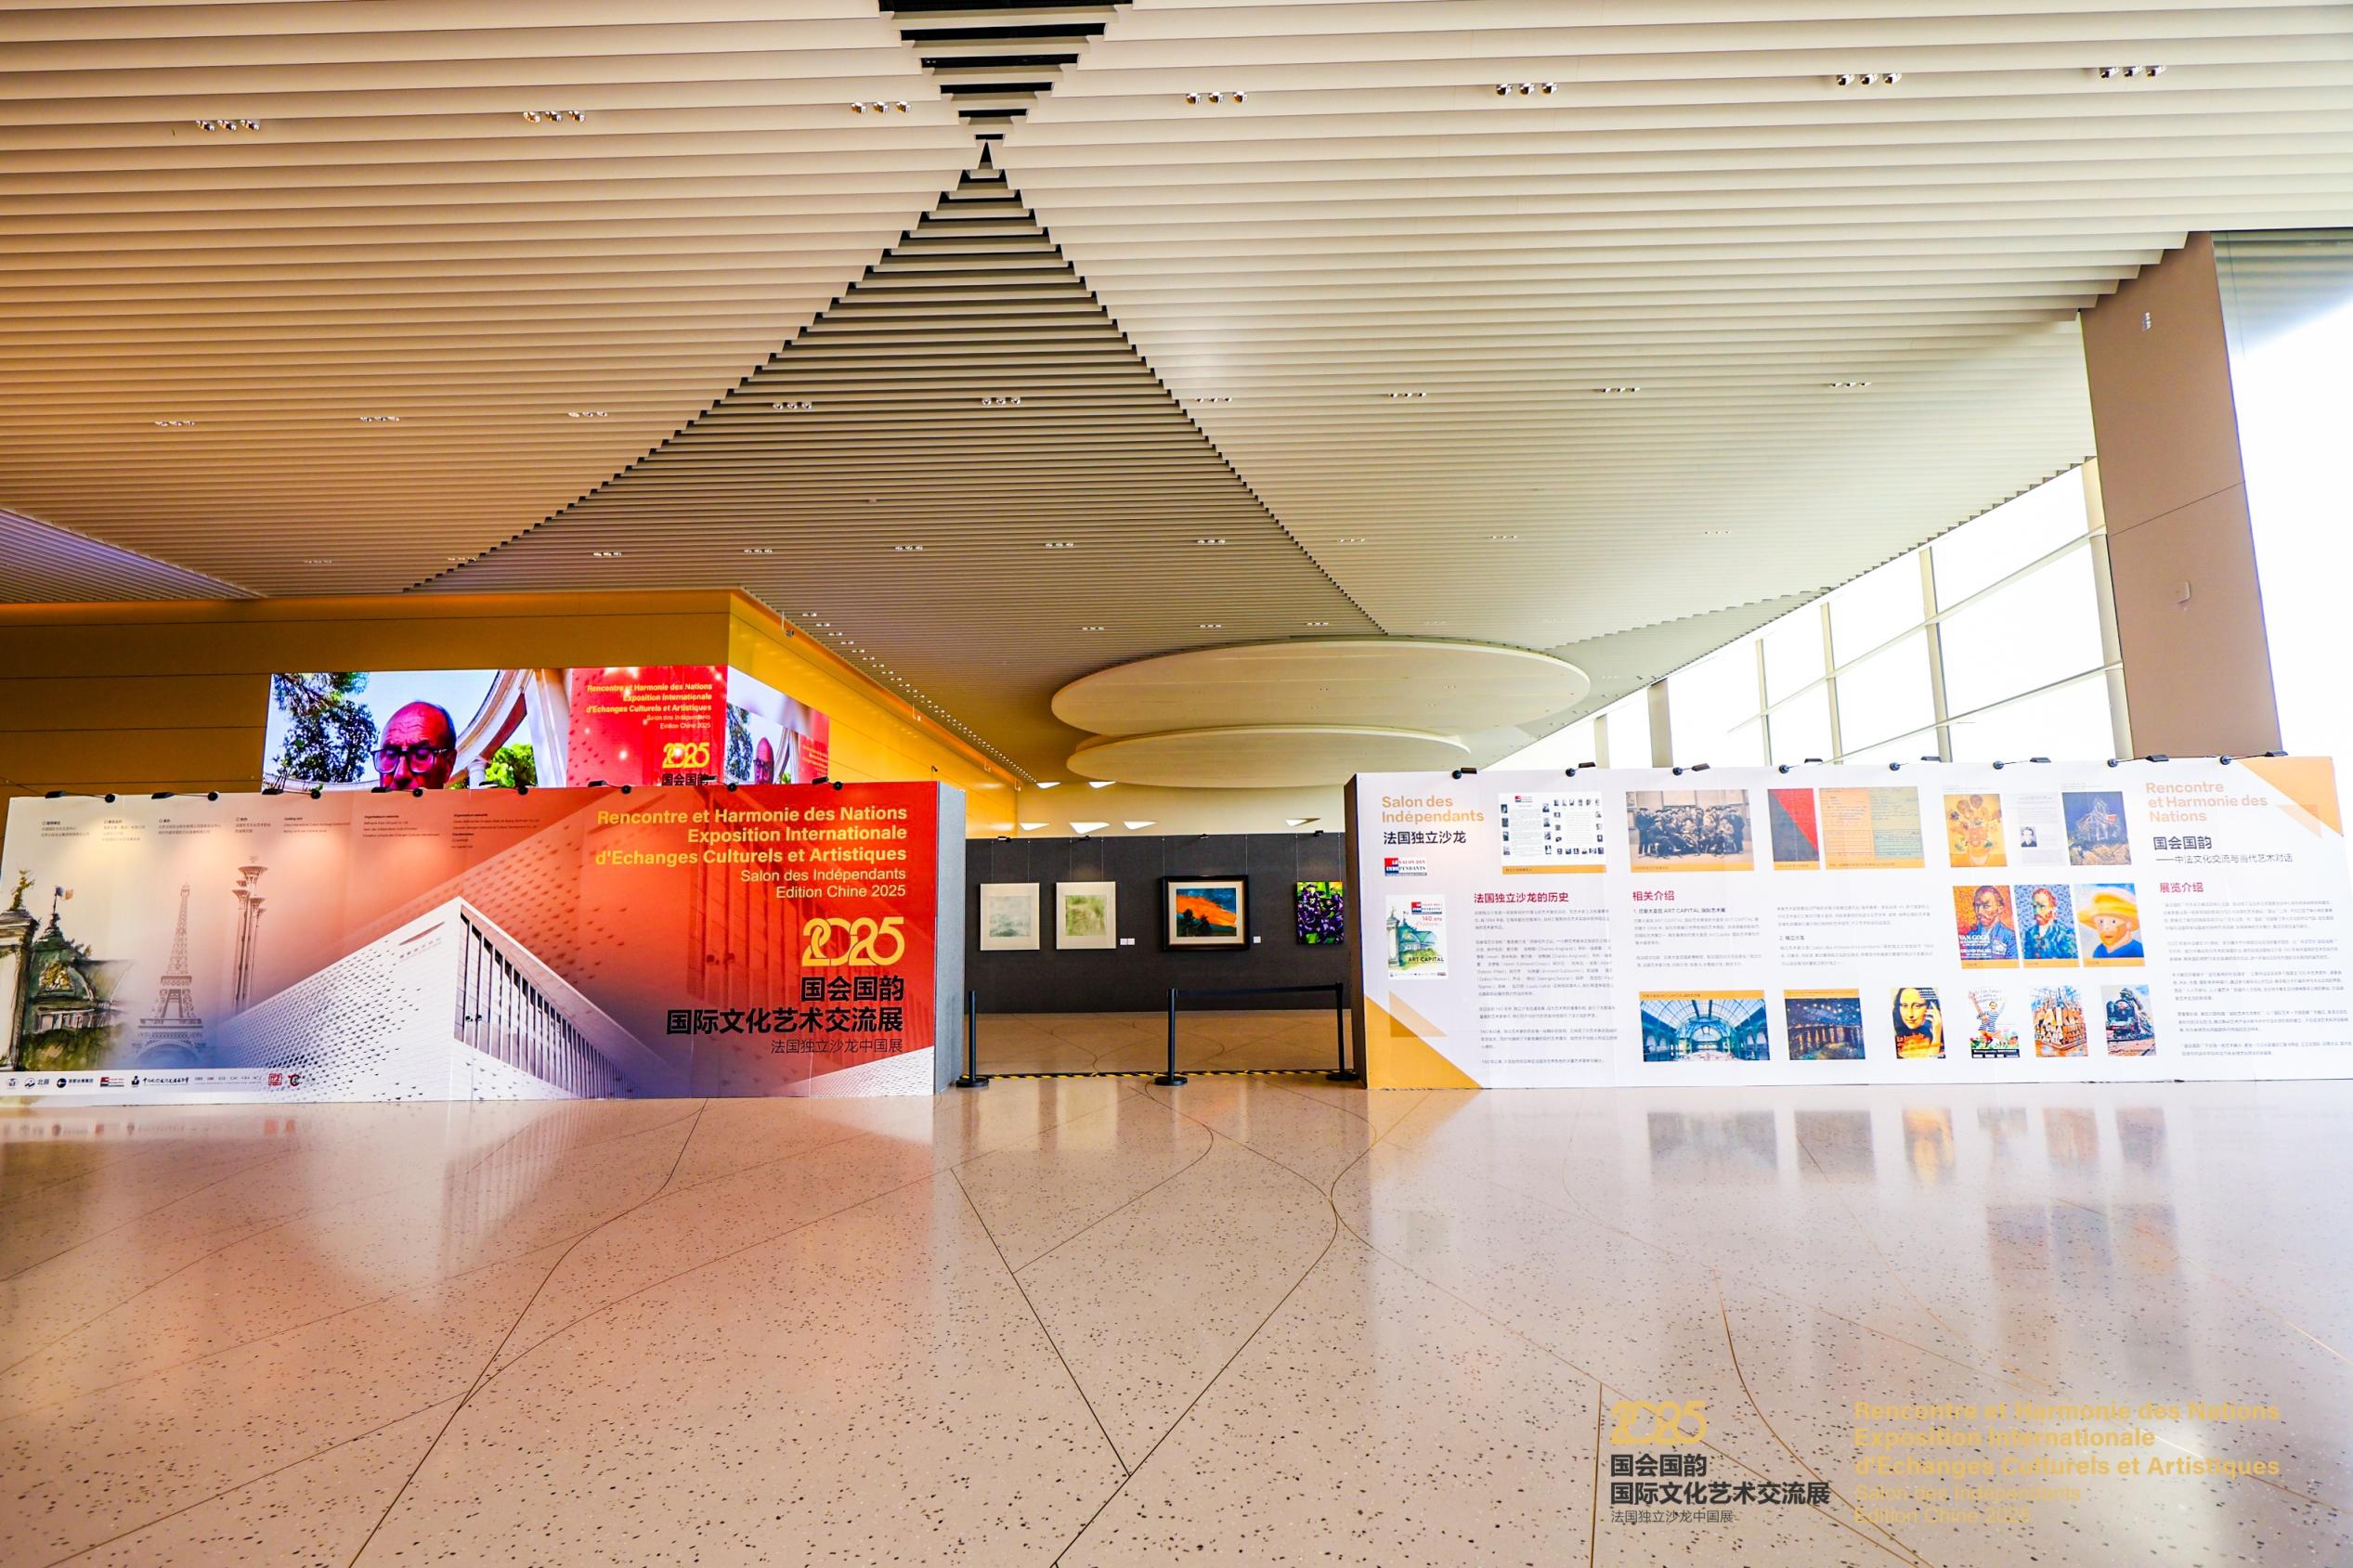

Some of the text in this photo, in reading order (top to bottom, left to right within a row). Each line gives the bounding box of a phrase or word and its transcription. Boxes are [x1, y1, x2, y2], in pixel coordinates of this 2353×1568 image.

[623, 693, 712, 703] Exposition Internationale
[672, 705, 712, 713] Artistiques
[662, 743, 710, 769] 2025
[2146, 782, 2224, 794] Rencontre
[1382, 795, 1453, 808] Salon des
[2148, 795, 2268, 808] et Harmonie des
[597, 806, 907, 824] Rencontre et Harmonie des Nations
[1382, 810, 1485, 824] Indépendants
[2150, 810, 2207, 823] Nations
[687, 825, 907, 846] Exposition Internationale
[1384, 830, 1466, 845] 法国独立沙龙
[2153, 836, 2212, 850] 国会国韵
[595, 847, 907, 868] d'Echanges Culturels et Artistiques
[740, 867, 906, 884] Salon des Indépendants
[776, 884, 906, 899] Edition Chine 2025
[2160, 882, 2204, 893] 展览介绍
[1474, 891, 1569, 904] 法国独立沙龙的历史
[1632, 890, 1675, 901] 相关介绍
[801, 916, 905, 966] 2025
[800, 975, 904, 1003] 国会国韵
[666, 1006, 904, 1035] 国际文化艺术交流展
[771, 1038, 904, 1055] 法国独立沙龙中国展
